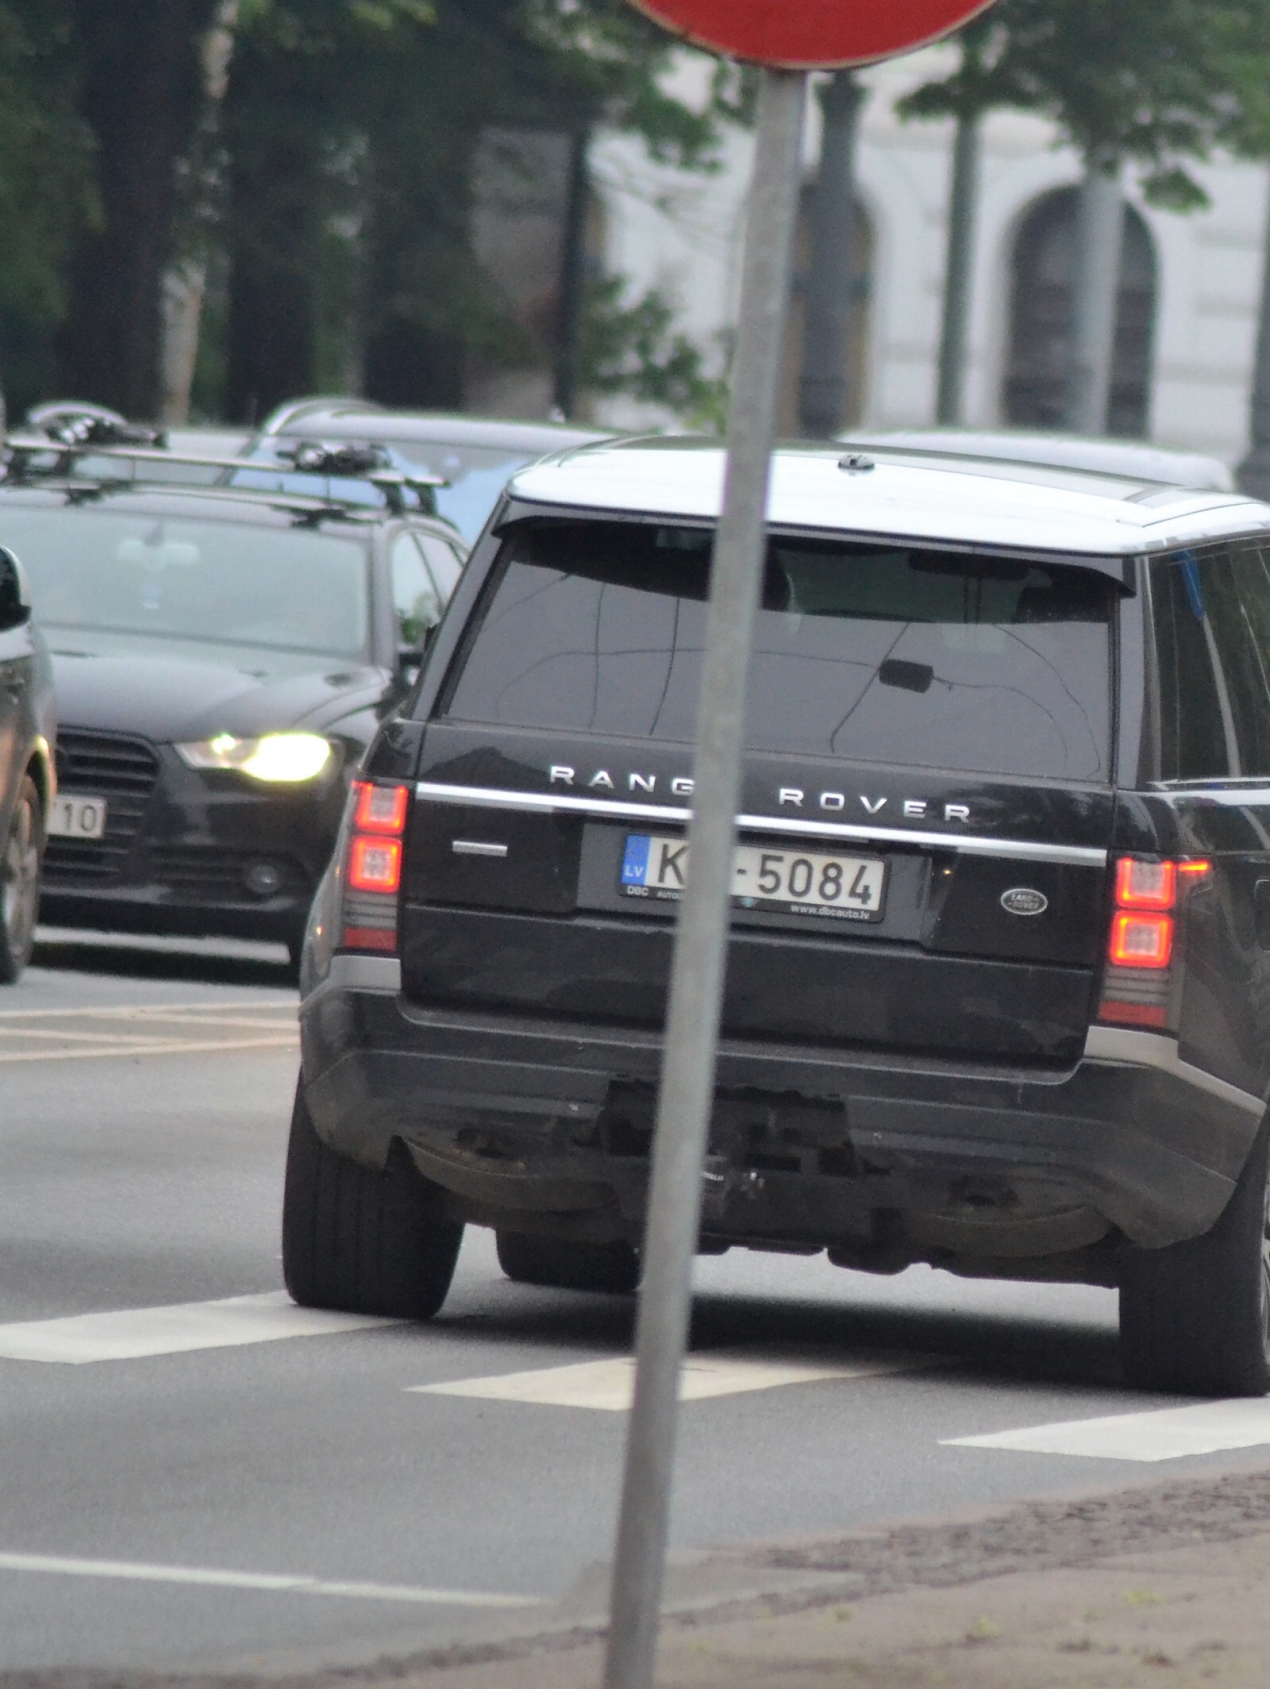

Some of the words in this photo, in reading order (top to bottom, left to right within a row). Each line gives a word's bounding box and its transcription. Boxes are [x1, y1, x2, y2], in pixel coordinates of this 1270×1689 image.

[549, 765, 696, 797] RANG
[779, 787, 971, 824] ROVER
[63, 803, 97, 832] 10
[624, 865, 645, 878] LV
[657, 843, 873, 905] K-5084
[789, 904, 870, 920] www.dbcauto.lv
